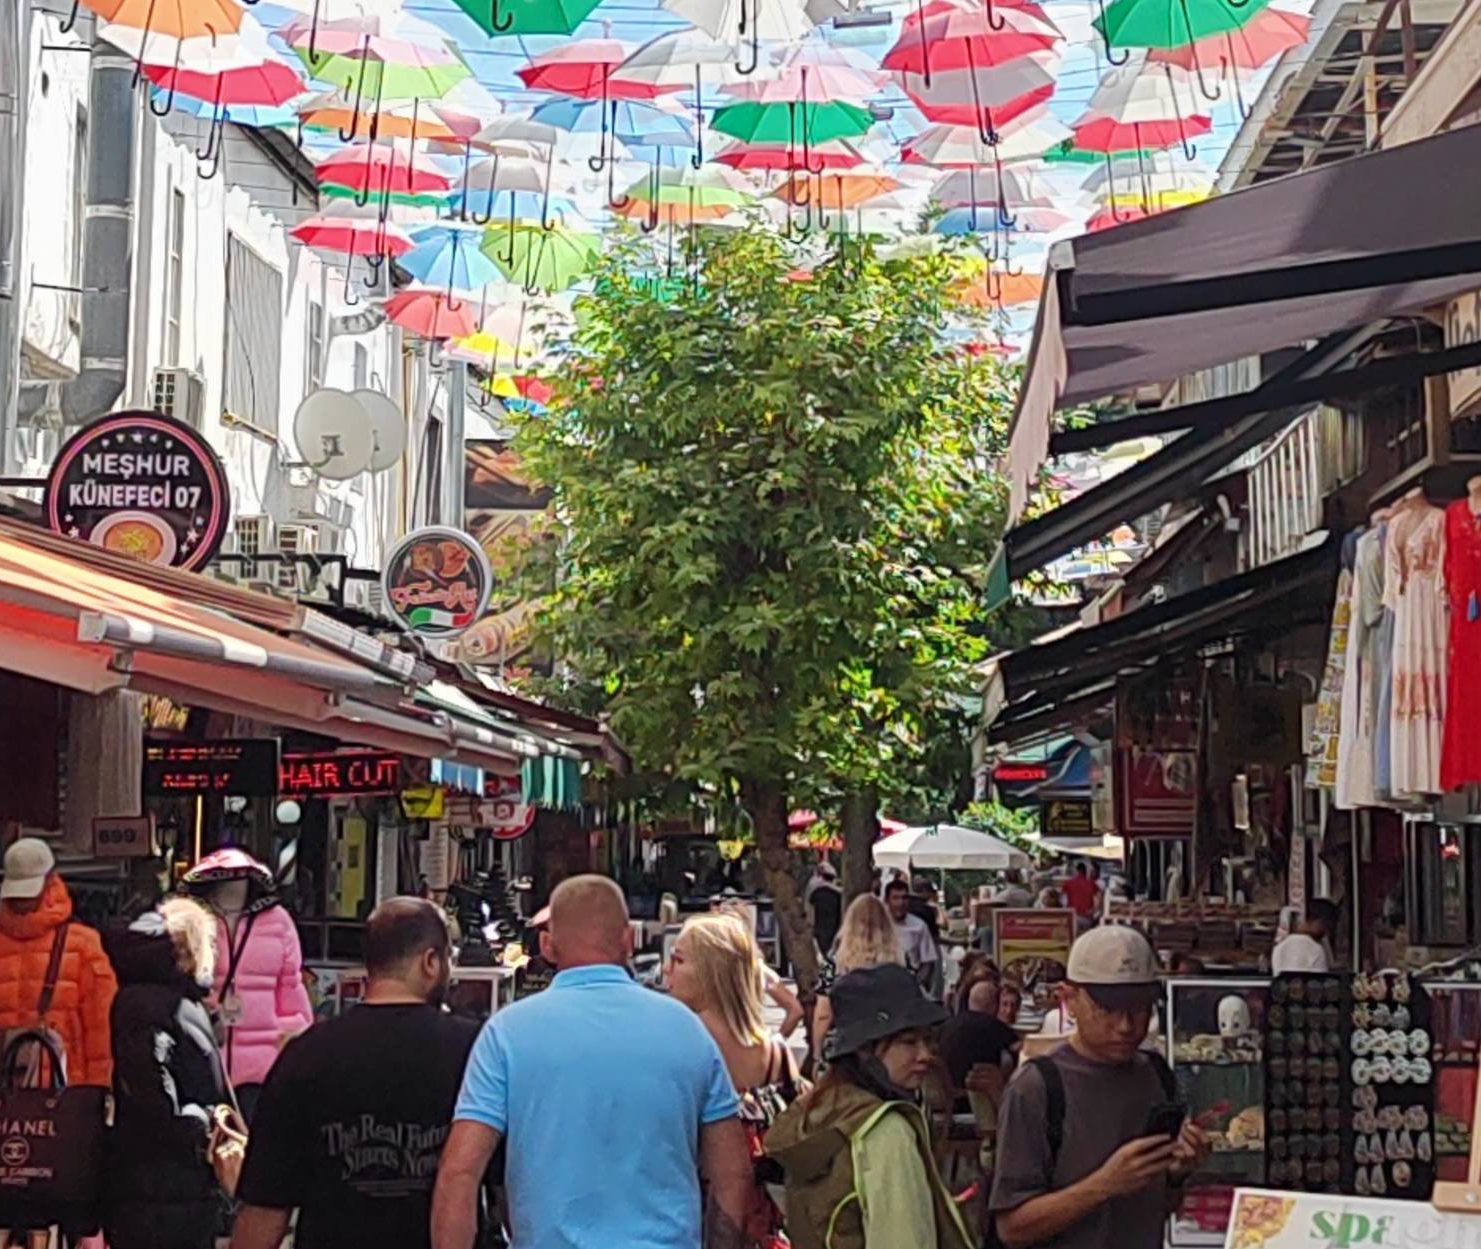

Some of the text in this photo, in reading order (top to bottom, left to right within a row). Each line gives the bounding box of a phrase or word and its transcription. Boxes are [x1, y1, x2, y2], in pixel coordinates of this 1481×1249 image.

[82, 453, 190, 479] MEŞHUR
[70, 480, 201, 508] KÜNEFECİ 07
[279, 760, 399, 789] HAIR CUT
[321, 1122, 358, 1156] The
[361, 1114, 402, 1147] Real
